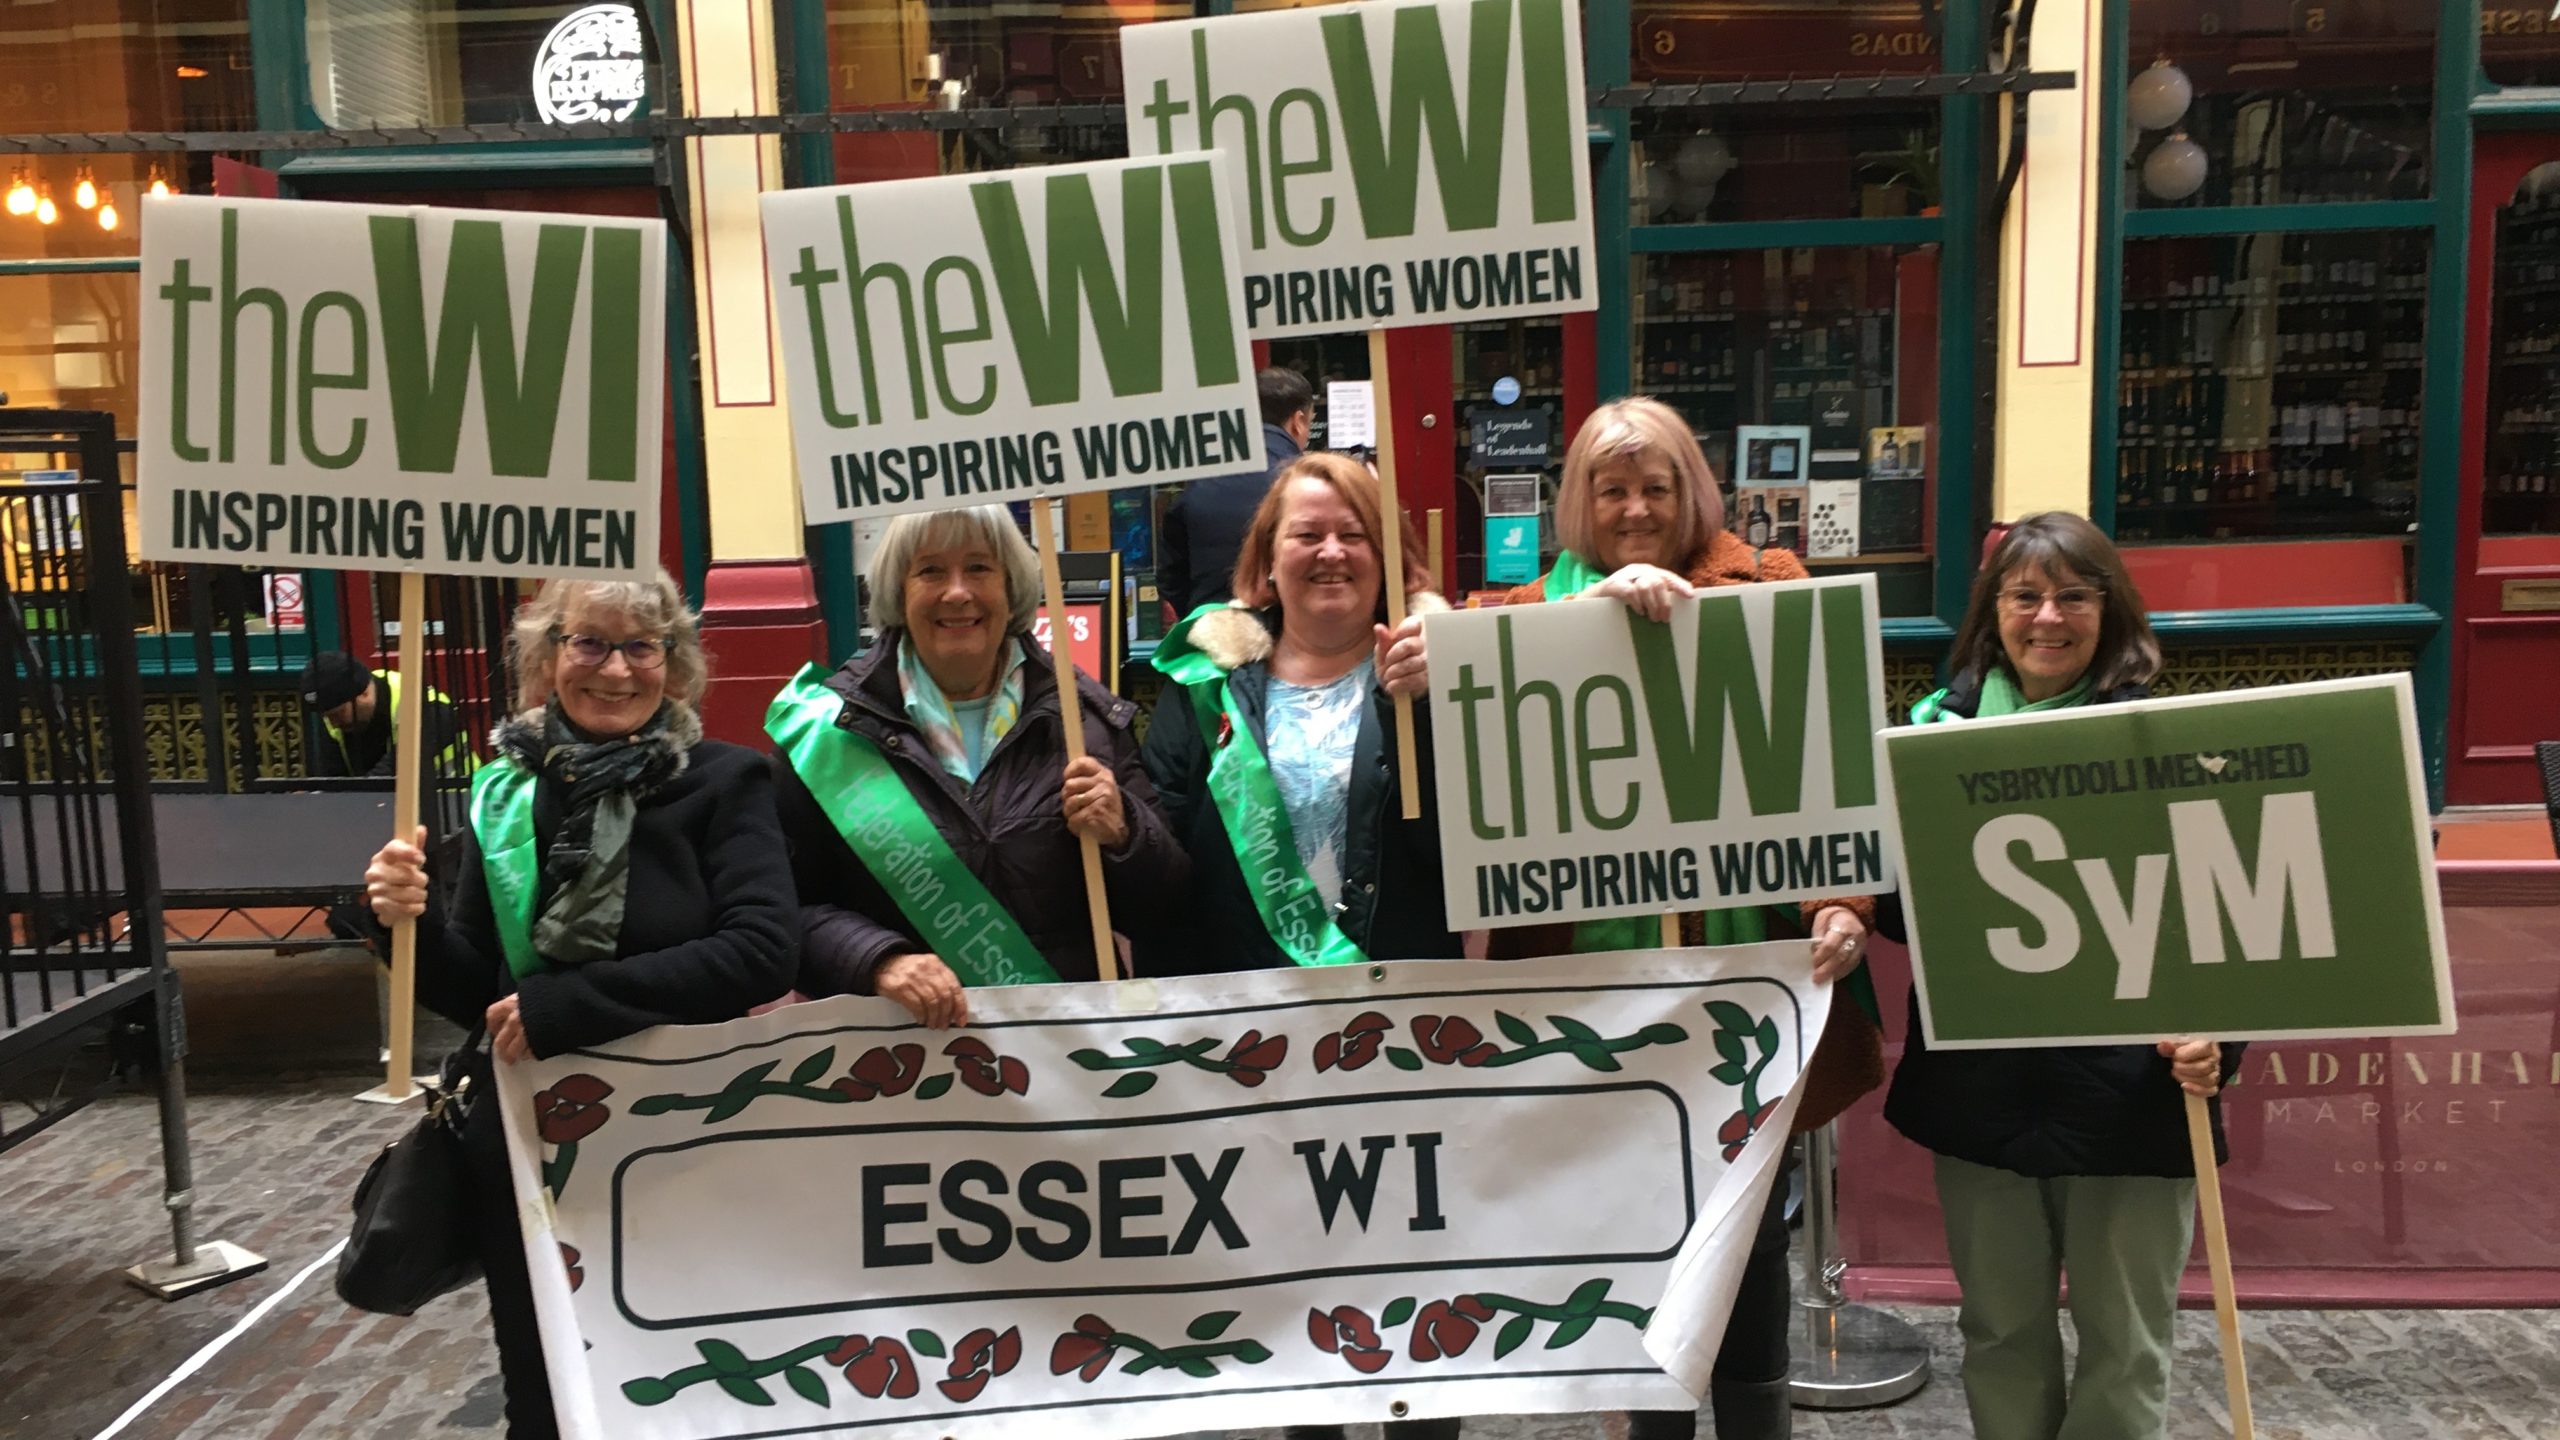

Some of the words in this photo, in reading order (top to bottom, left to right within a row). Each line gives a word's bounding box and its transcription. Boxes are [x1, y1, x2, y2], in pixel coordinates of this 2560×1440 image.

[1243, 263, 1395, 329] PIRING
[1405, 246, 1582, 314] WOMEN
[831, 431, 1064, 510] INSPIRING
[1073, 408, 1250, 480] WOMEN
[172, 489, 424, 560] INSPIRING
[441, 501, 636, 569] WOMEN
[1957, 759, 2138, 806] YSBRYDOLI
[1260, 867, 1305, 897] of
[1476, 847, 1699, 919] INSPIRING
[1710, 830, 1881, 896] WOMEN
[1973, 791, 2338, 1000] SyM
[932, 902, 990, 941] of
[2229, 1051, 2560, 1086] ADENHA
[2266, 1100, 2506, 1124] MARKET
[2334, 1160, 2448, 1174] LONDON
[862, 1147, 1251, 1268] ESSEX
[1293, 1132, 1446, 1236] WI
